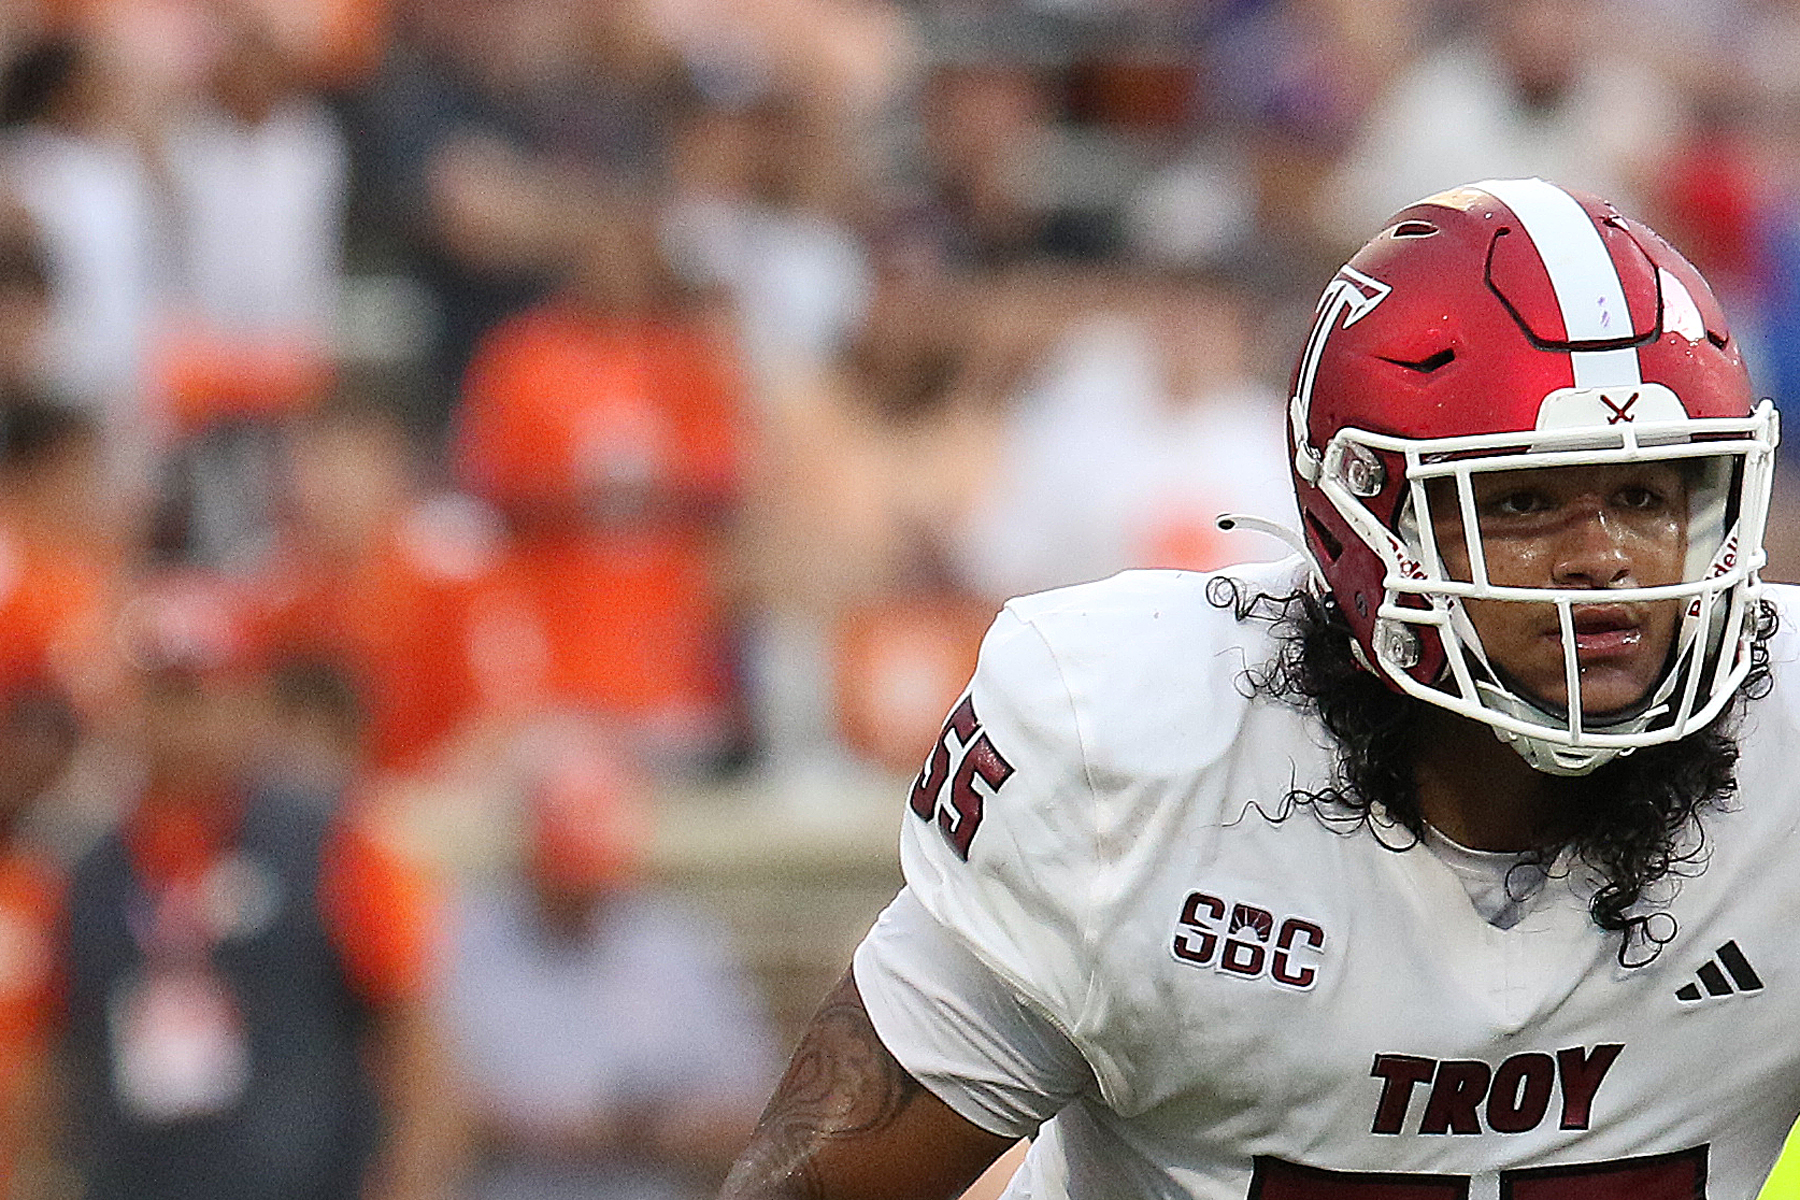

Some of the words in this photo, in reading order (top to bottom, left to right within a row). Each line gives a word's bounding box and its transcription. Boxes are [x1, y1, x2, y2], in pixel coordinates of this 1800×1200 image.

[909, 693, 1015, 862] 55
[1171, 890, 1326, 990] SBC
[1370, 1043, 1625, 1135] TROY
